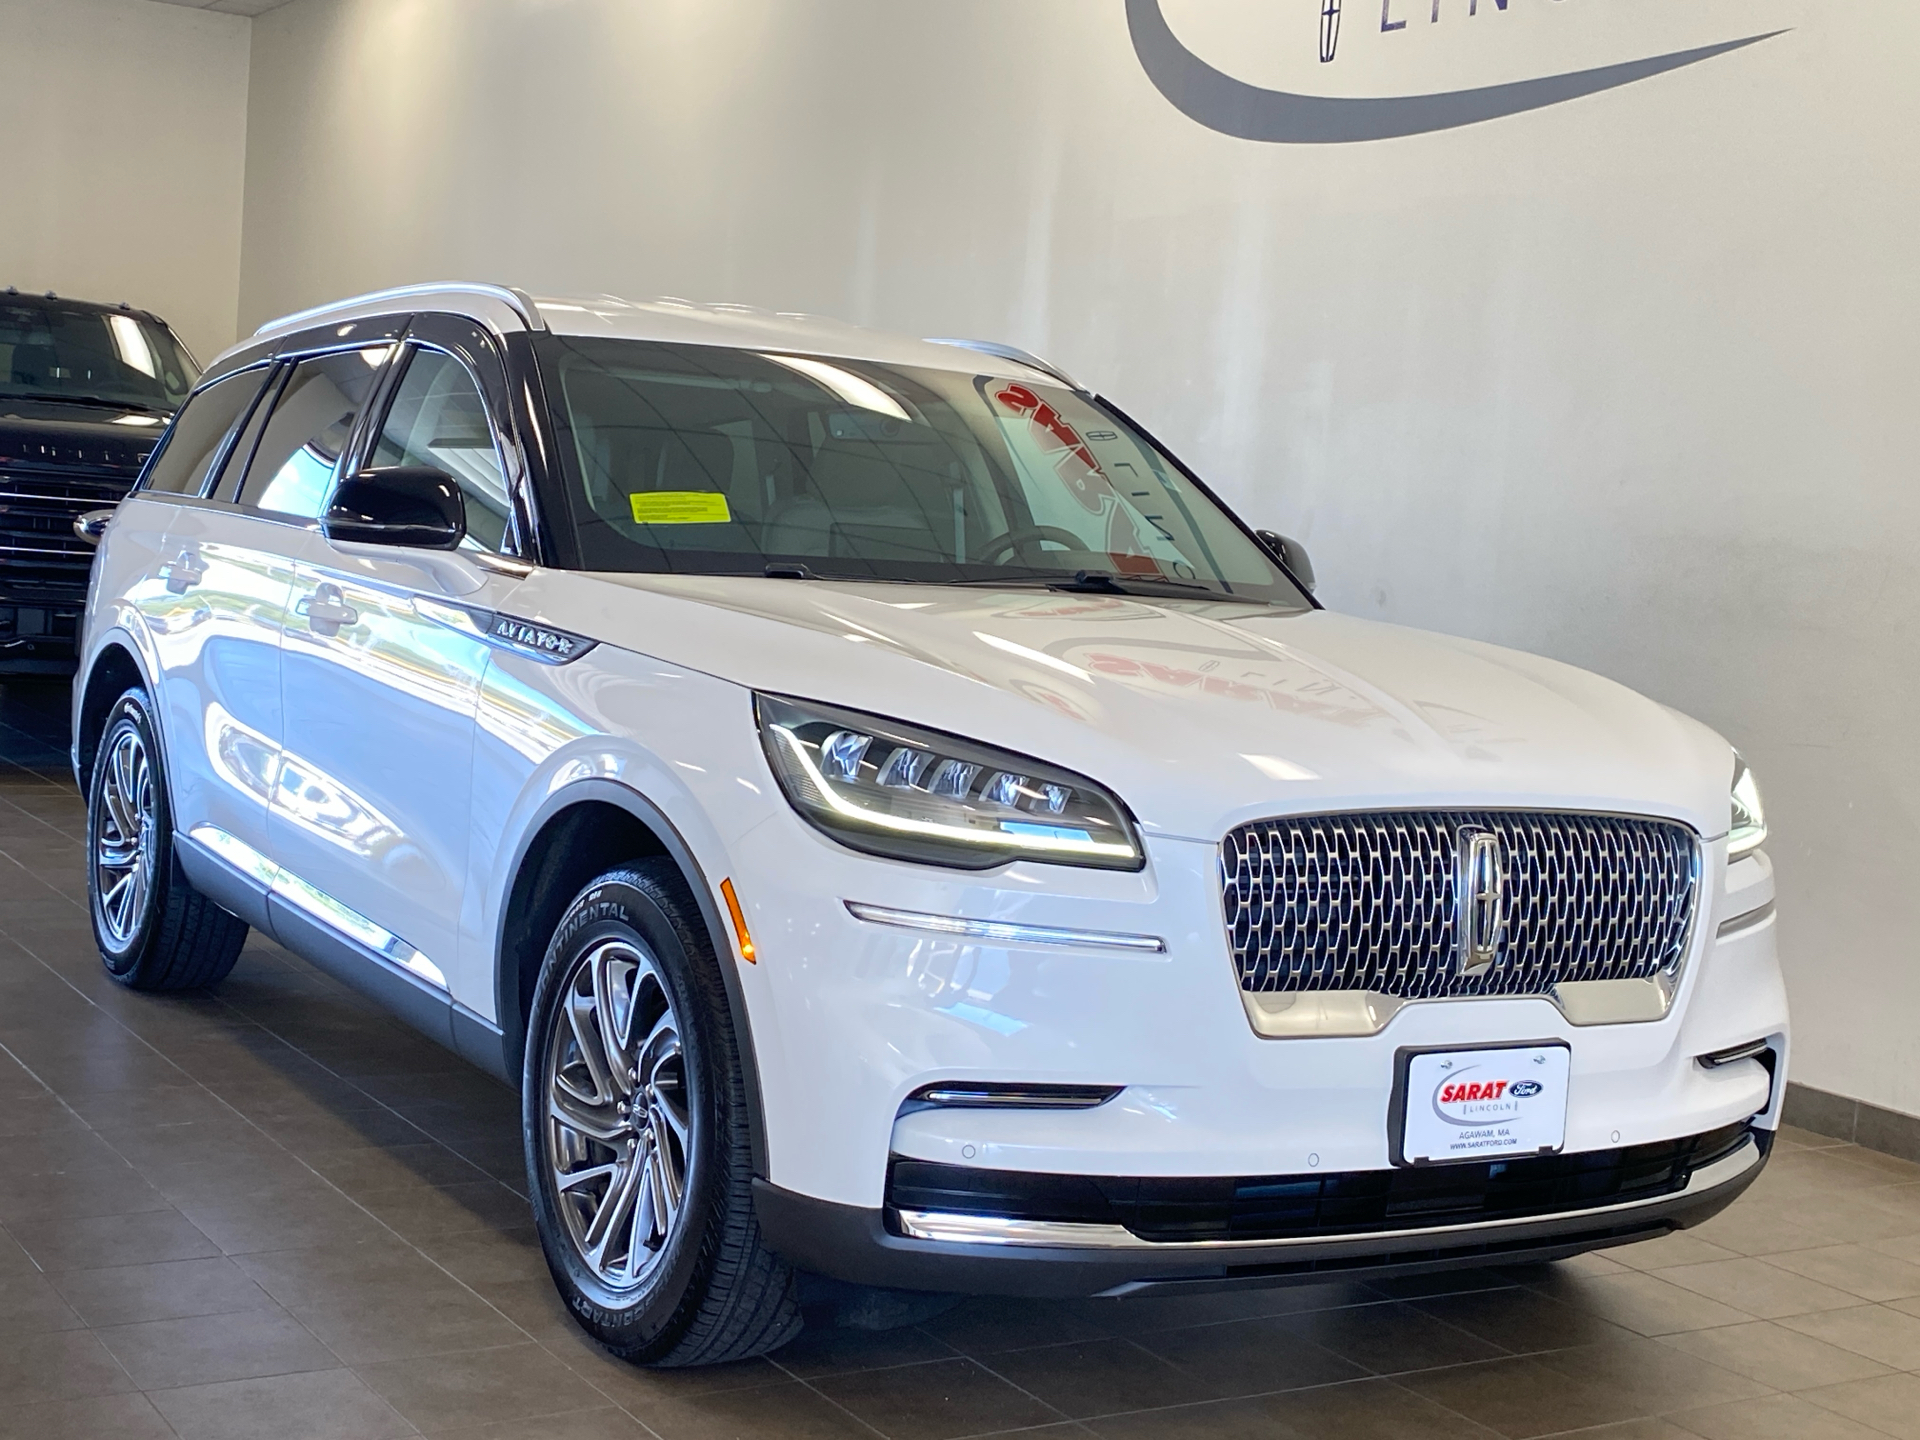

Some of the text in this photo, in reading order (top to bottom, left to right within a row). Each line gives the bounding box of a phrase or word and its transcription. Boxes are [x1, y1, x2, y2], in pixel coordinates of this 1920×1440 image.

[496, 620, 574, 654] AVIATOR
[1440, 1081, 1540, 1102] SARAT Ford
[1470, 1103, 1511, 1112] LINCOLN
[1459, 1130, 1495, 1139] AGAWAM,
[1450, 1139, 1517, 1150] WWW.SARATFORD.COM
